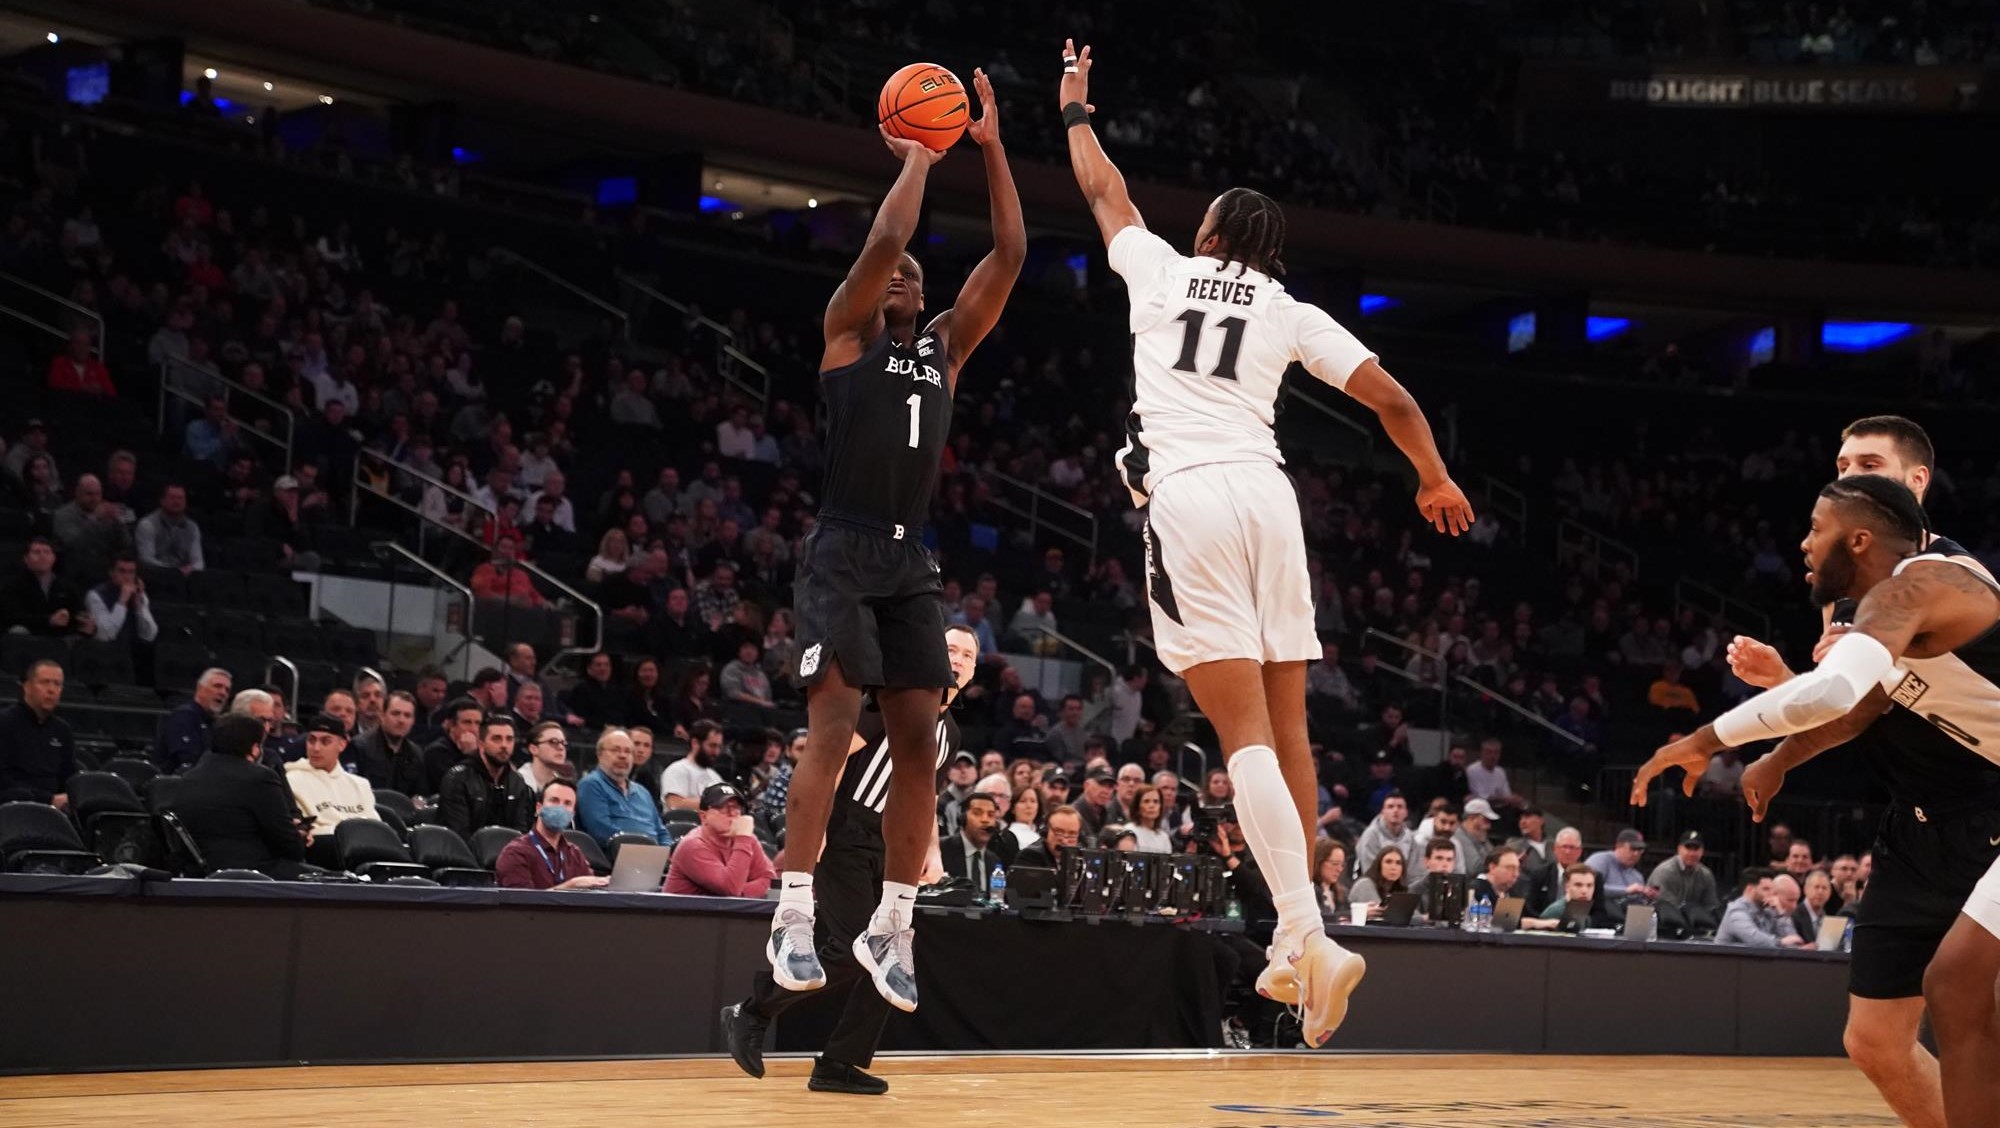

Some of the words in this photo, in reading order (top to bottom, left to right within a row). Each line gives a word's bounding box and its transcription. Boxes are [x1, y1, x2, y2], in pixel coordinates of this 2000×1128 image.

[920, 74, 958, 93] ELITE
[1609, 79, 1664, 101] BUD
[1666, 79, 1744, 102] LIGHT
[1753, 79, 1825, 103] BLUE
[1830, 79, 1917, 103] SEATS
[1186, 278, 1256, 306] REEVES
[1170, 308, 1249, 382] 11
[884, 356, 942, 389] BULER
[906, 393, 922, 449] 1
[893, 524, 905, 540] B
[1914, 807, 1928, 823] B
